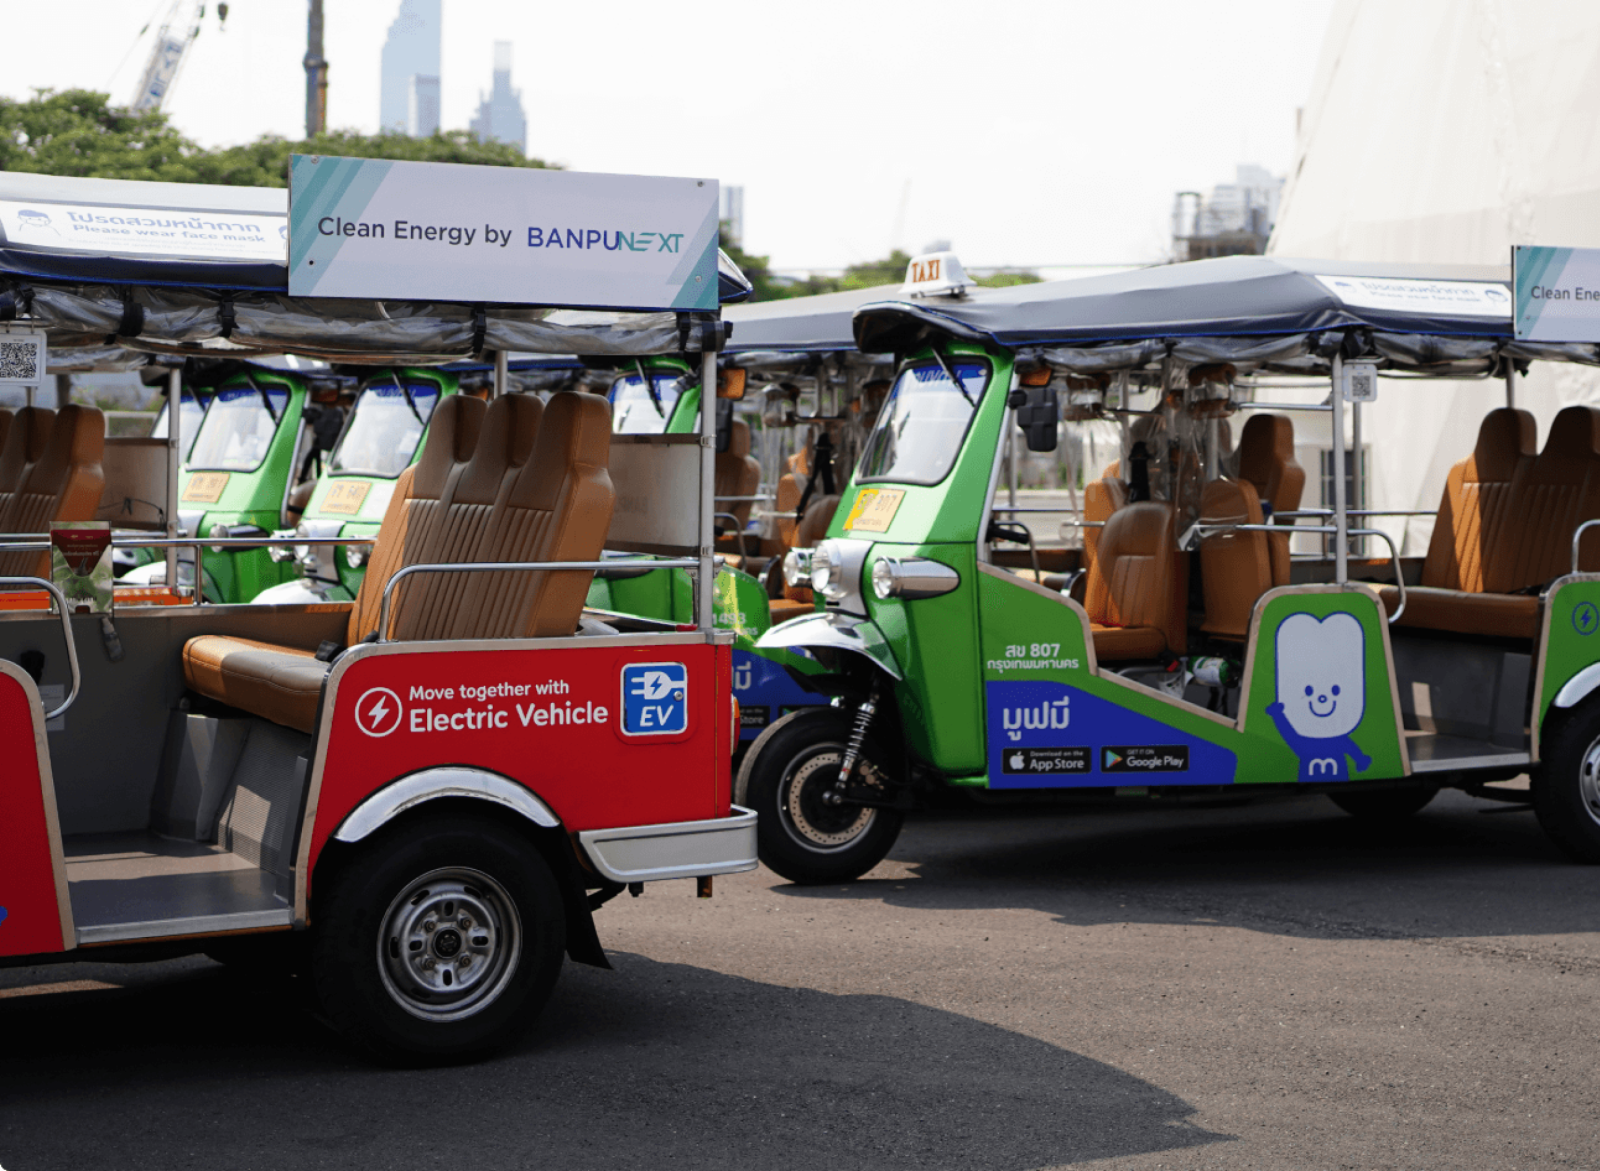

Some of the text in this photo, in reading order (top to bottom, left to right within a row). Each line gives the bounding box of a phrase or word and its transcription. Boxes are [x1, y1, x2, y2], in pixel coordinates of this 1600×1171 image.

[67, 211, 261, 233] โปรดสวมหน้ากาก
[317, 216, 385, 239] Clean
[394, 220, 476, 246] Energy
[484, 224, 512, 247] by
[73, 224, 131, 235] Please
[135, 229, 176, 238] wear
[182, 230, 218, 241] face
[223, 233, 266, 243] mask
[911, 259, 941, 283] TAXI
[1530, 285, 1571, 300] Clean
[1030, 643, 1061, 658] 807
[987, 659, 1080, 674] กรุงเทพมหานคร
[409, 679, 570, 702] Move together with
[409, 701, 609, 733] Electric Vehicle
[639, 705, 675, 728] EV
[1003, 695, 1070, 741] มูฟมี
[1029, 758, 1085, 771] App Store
[1126, 756, 1185, 770] Google Play
